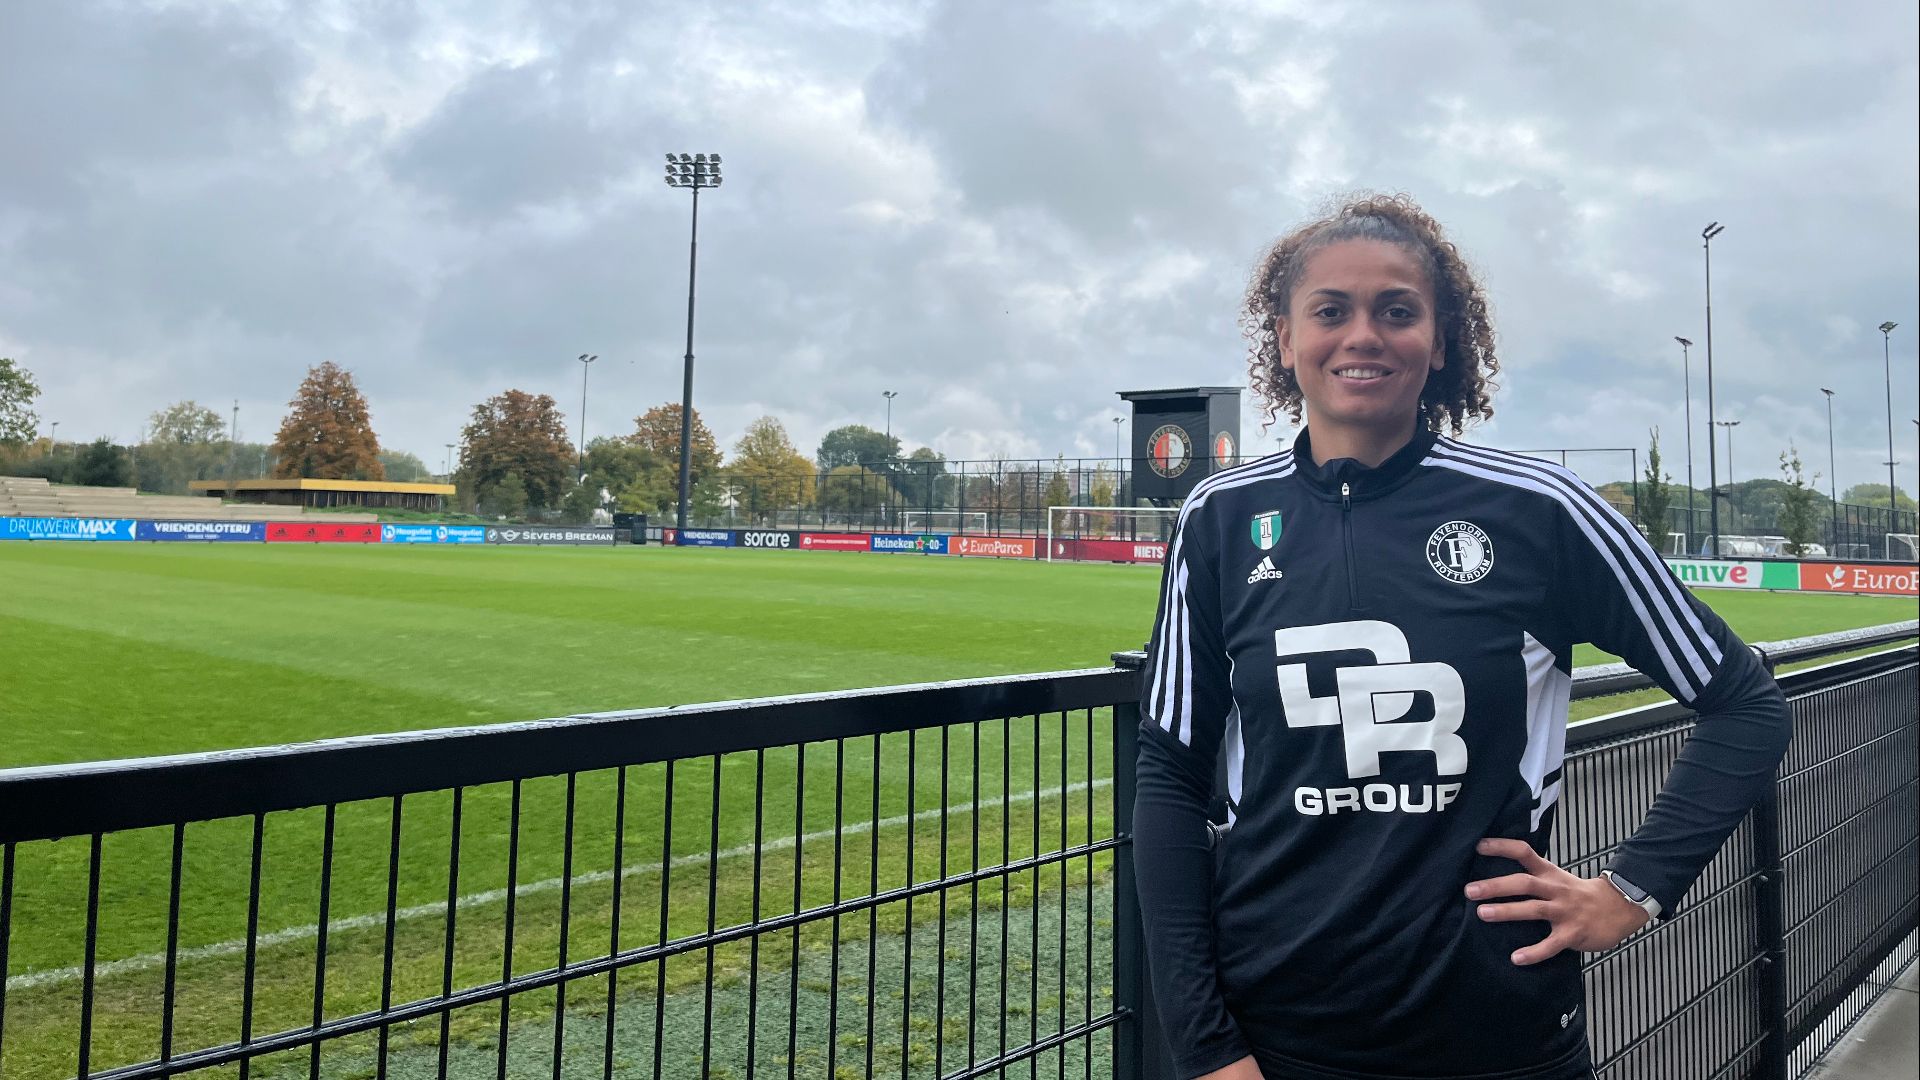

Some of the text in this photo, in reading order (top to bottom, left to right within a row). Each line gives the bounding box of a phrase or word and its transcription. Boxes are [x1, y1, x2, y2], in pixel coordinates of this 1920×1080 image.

[9, 519, 117, 534] DRUKWERKMAX
[154, 523, 251, 534] VRIENDENLOTERIJ
[1261, 522, 1271, 538] 1
[522, 531, 563, 540] SEVERS
[565, 532, 613, 541] BREEMAN
[744, 532, 790, 547] sorare
[1431, 523, 1487, 546] FEYENOORD
[874, 537, 914, 549] Heineken
[970, 540, 1023, 554] EuroParcs
[1134, 545, 1164, 558] NIETS
[1444, 536, 1472, 567] F
[1434, 558, 1490, 581] ROTTERDAM
[1275, 619, 1468, 779] DR
[1294, 782, 1462, 816] GROUP
